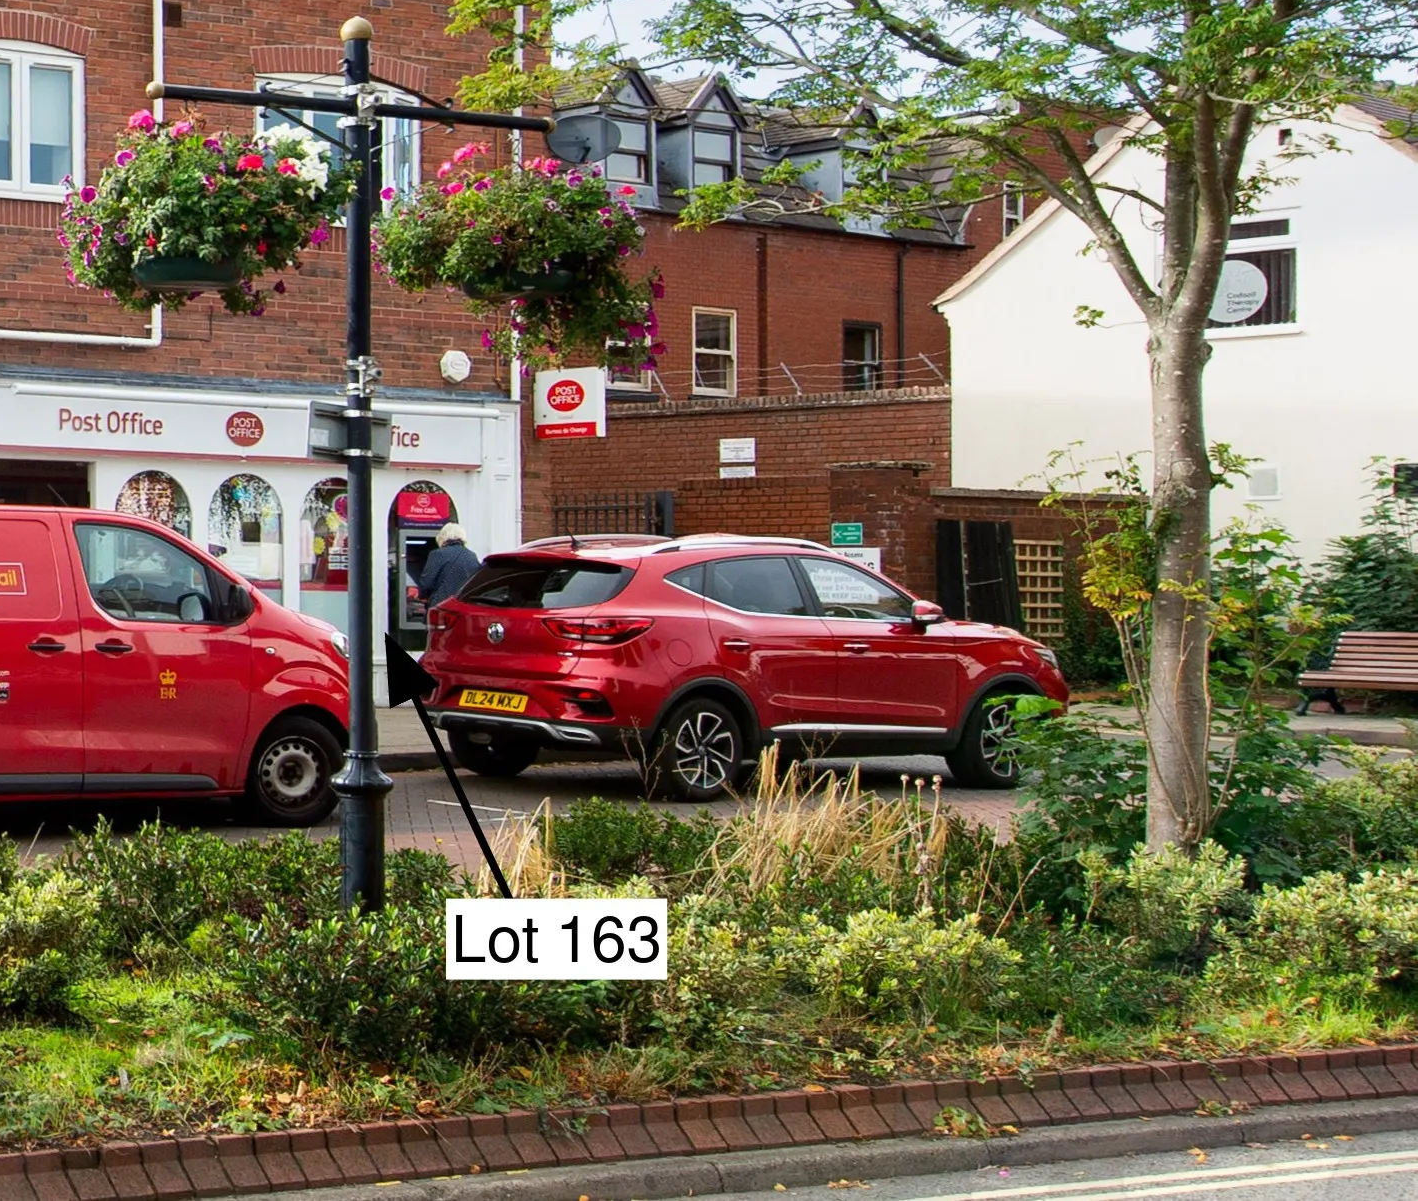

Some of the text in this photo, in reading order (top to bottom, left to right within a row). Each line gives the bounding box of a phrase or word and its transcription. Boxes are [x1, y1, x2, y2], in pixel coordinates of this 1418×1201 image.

[1227, 291, 1256, 299] Codsall
[554, 385, 578, 395] POST
[550, 394, 581, 405] OFFICE
[58, 408, 163, 436] Post Office
[233, 417, 257, 428] POST
[228, 428, 261, 439] OFFICE
[390, 425, 420, 448] fice
[464, 691, 523, 710] DL24 MXJ
